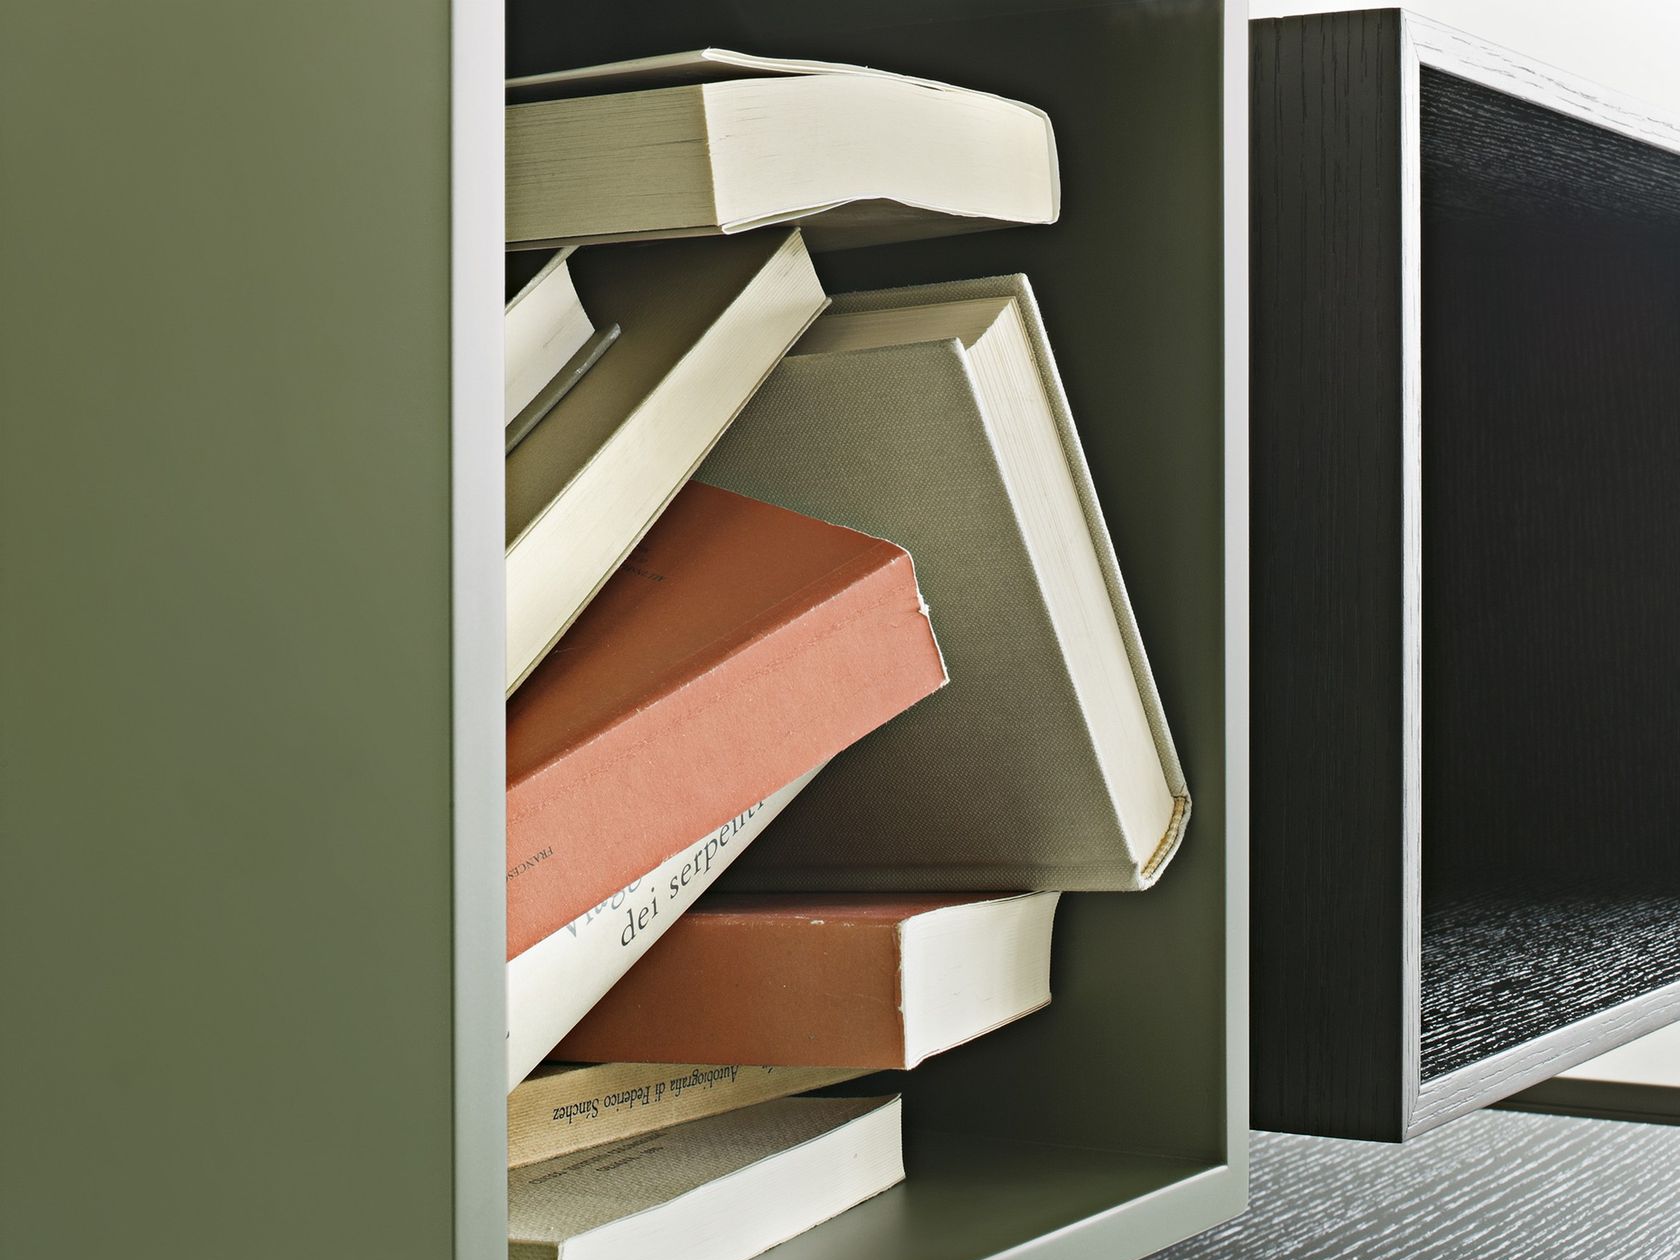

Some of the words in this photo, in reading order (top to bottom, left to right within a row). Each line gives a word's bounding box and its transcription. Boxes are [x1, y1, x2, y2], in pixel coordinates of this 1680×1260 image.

[507, 846, 554, 881] FRANCES
[621, 887, 659, 947] dei
[655, 1082, 666, 1101] di
[670, 1065, 739, 1098] Autobiografia
[553, 1098, 599, 1124] Sánchez
[603, 1085, 651, 1112] Federico
